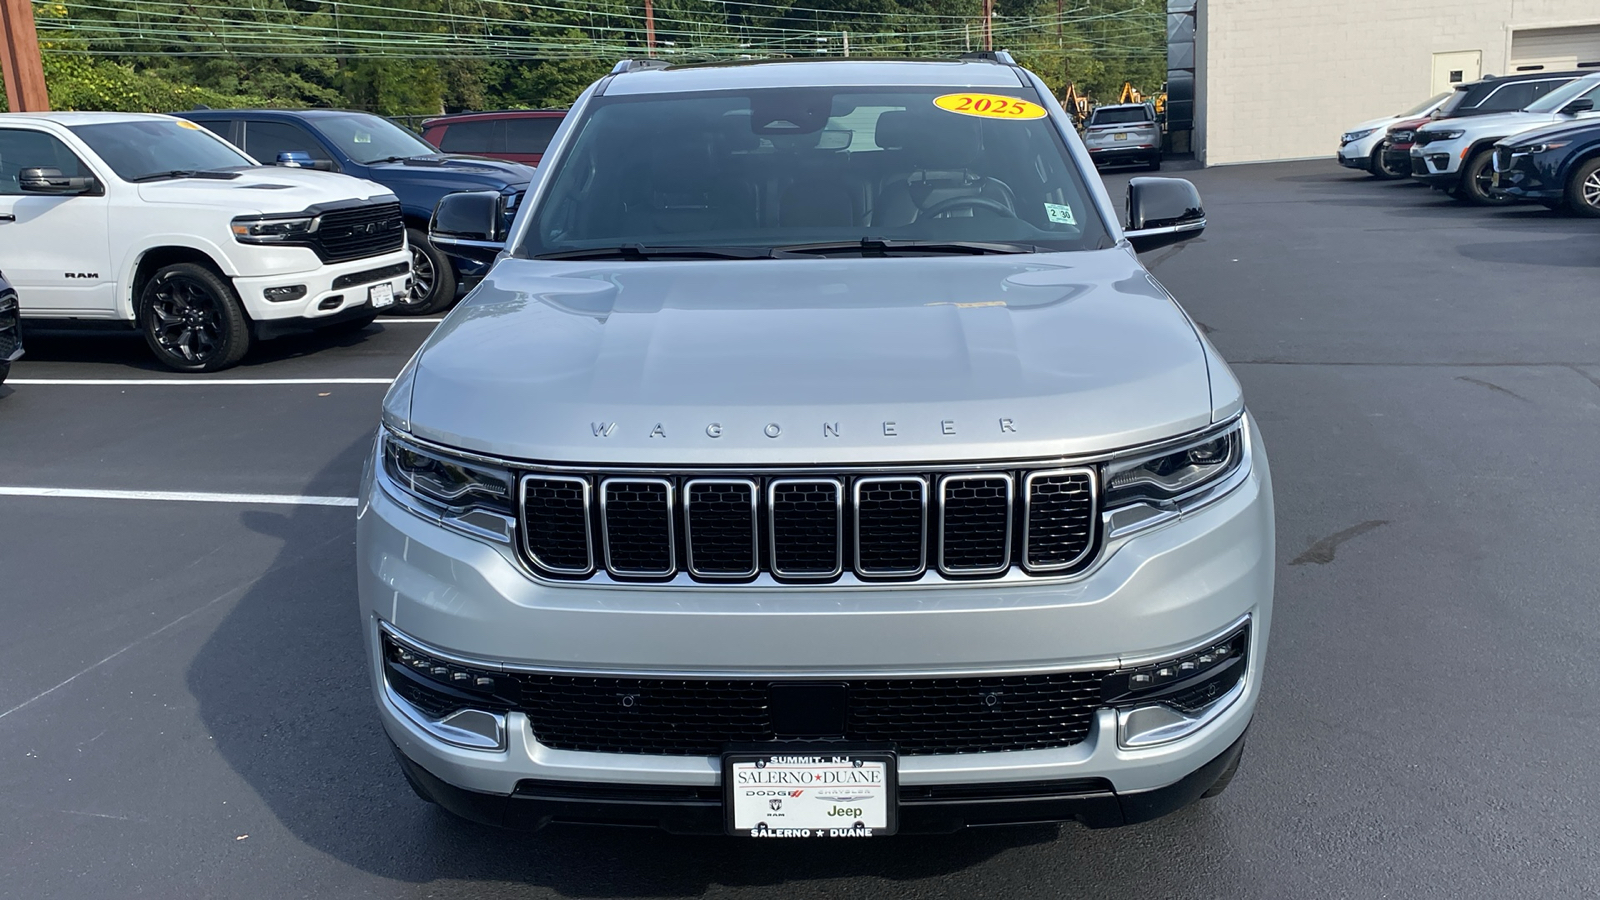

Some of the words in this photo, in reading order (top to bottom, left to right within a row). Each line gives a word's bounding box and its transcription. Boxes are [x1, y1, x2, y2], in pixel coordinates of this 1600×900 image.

[954, 97, 1027, 115] 2025
[1060, 210, 1070, 218] 30
[591, 416, 1018, 439] WAGONEER
[831, 755, 850, 764] NJ
[738, 771, 813, 784] SALERNO
[823, 770, 881, 783] DUANE
[827, 805, 863, 819] Jeep
[750, 828, 811, 838] SALERNO
[829, 828, 873, 838] DUANE
